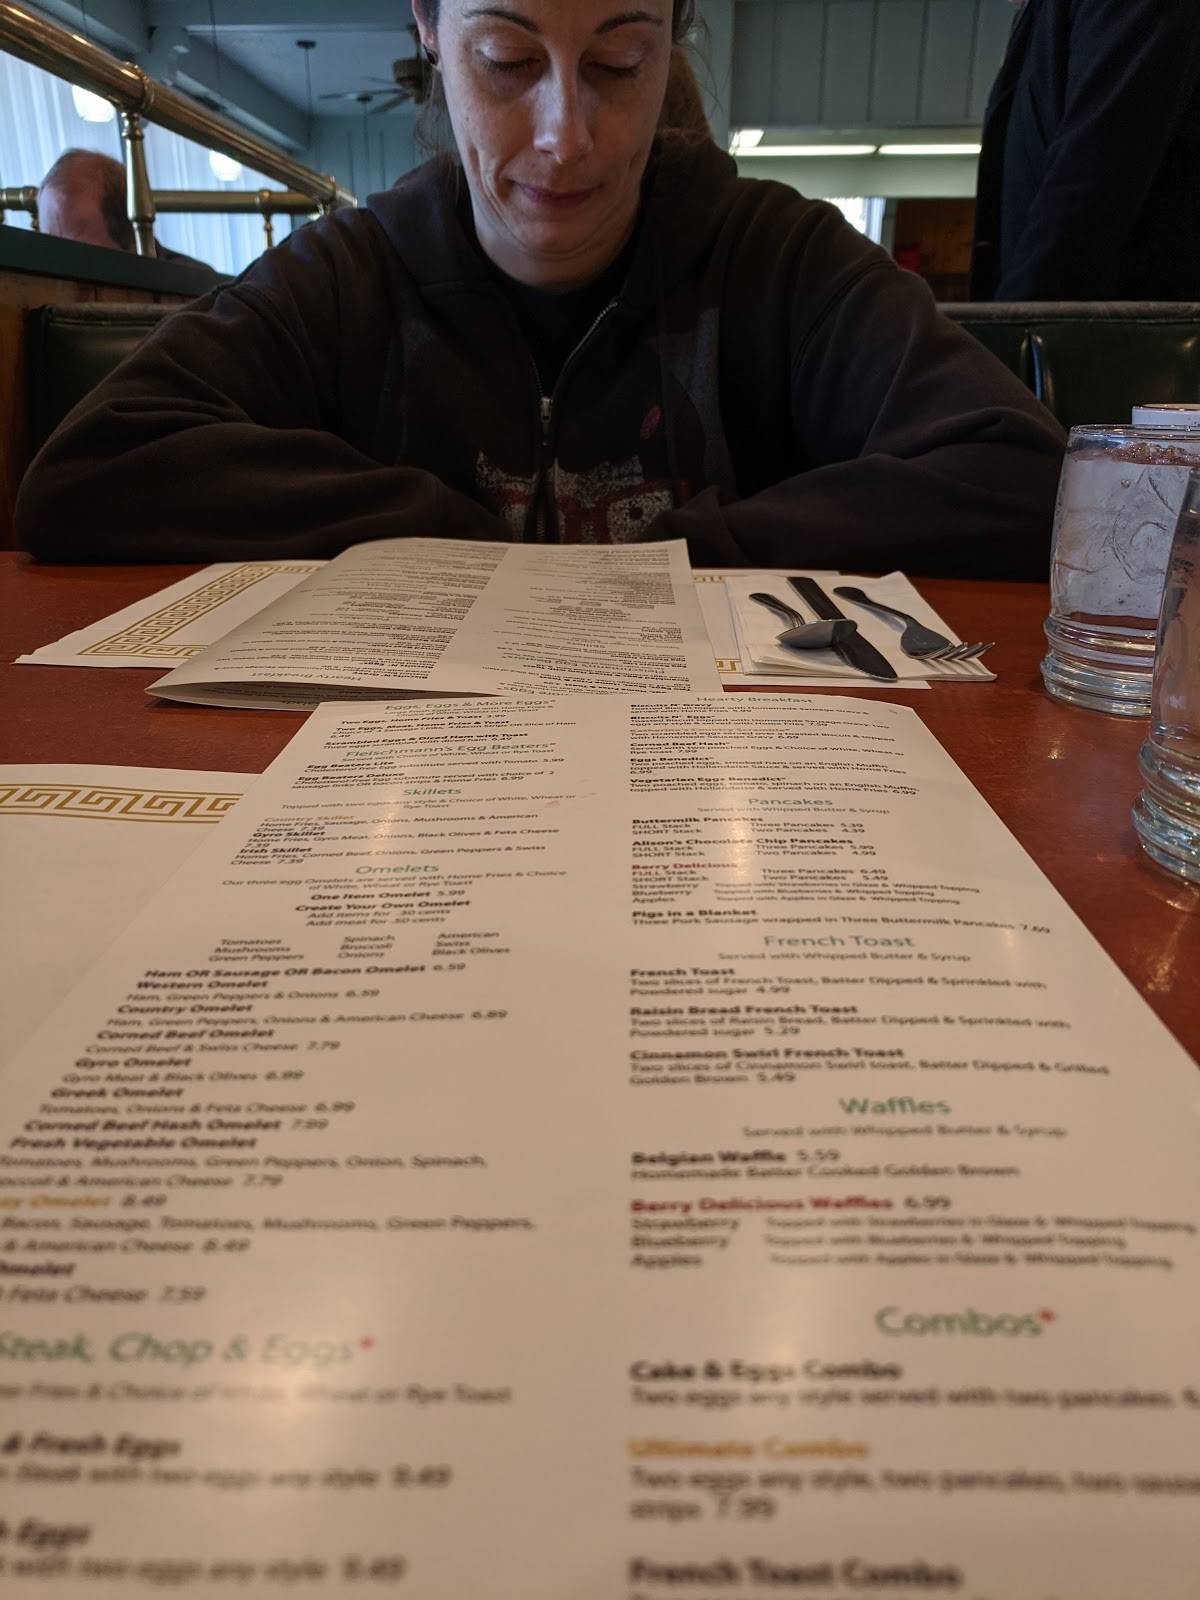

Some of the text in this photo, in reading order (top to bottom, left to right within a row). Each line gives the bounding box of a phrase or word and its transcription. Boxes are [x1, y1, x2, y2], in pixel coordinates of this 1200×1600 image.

[347, 746, 454, 757] Fleischmann's
[402, 788, 462, 796] Skillets
[356, 865, 440, 874] Omelets
[632, 910, 664, 918] Pigs
[343, 934, 395, 943] Spinach
[764, 935, 915, 947] French Toast
[251, 954, 304, 962] Peppers
[212, 969, 281, 978] Sausage
[284, 968, 308, 976] OR
[312, 967, 362, 975] Bacon
[366, 965, 425, 974] Omelet
[631, 968, 735, 977] French Toast
[137, 980, 268, 989] Western Omelet
[630, 988, 704, 996] Powdered
[708, 988, 748, 997] sugar
[117, 1004, 253, 1015] Country Omelet
[630, 1004, 858, 1016] Raisin Bread French Toast
[97, 1029, 274, 1040] Corned Beef Omelet
[630, 1029, 708, 1038] Powdered
[630, 1048, 904, 1061] Cinnamon Swirl French Toast
[75, 1058, 192, 1070] Gyro Omelet
[51, 1086, 185, 1100] Greek Omelet
[839, 1095, 951, 1116] Waffles
[24, 1120, 99, 1132] Corned
[102, 1118, 149, 1131] Beef
[151, 1119, 202, 1131] Hash
[206, 1118, 282, 1131] Omelet
[10, 1136, 258, 1152] Fresh Vegetable Omelet
[631, 1151, 714, 1166] Belgian
[717, 1150, 787, 1164] Waffle
[30, 1195, 112, 1209] Omelet
[631, 1198, 692, 1216] Berry
[701, 1196, 804, 1212] Delicious
[808, 1195, 894, 1212] Waffles
[631, 1216, 739, 1231] Strawberry
[631, 1234, 729, 1249] Blueberry
[108, 1332, 214, 1367] Chop
[222, 1334, 248, 1363] &
[630, 1358, 904, 1386] Cake & Eggs Combo
[762, 1436, 870, 1459] Combo
[629, 1554, 964, 1591] French Toast Combo
